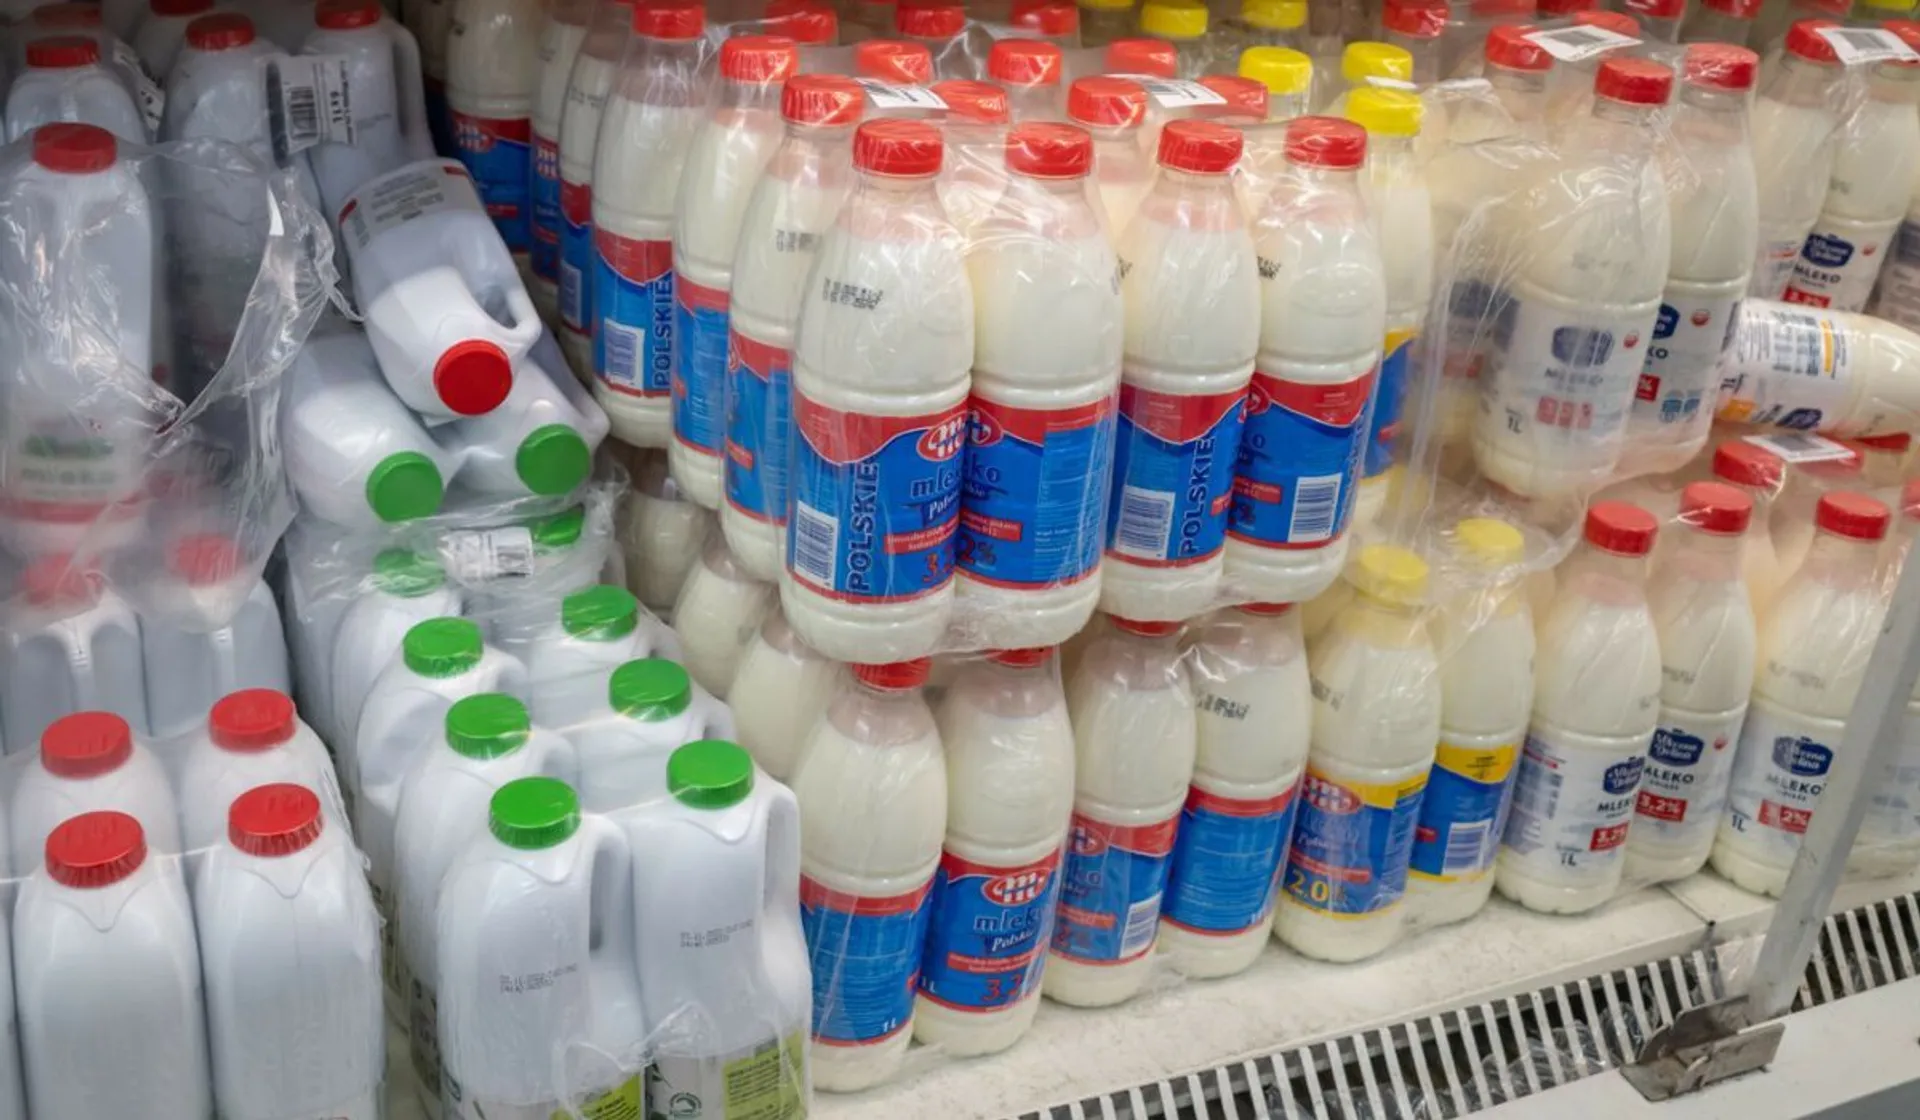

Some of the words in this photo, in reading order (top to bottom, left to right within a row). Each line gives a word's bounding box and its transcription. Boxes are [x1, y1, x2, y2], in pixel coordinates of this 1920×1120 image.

[653, 276, 673, 389] POLSKIE
[845, 457, 880, 594] POLSKIE
[1178, 435, 1216, 557] POLSKIE
[1732, 813, 1747, 833] 1L
[973, 907, 1040, 932] mlek
